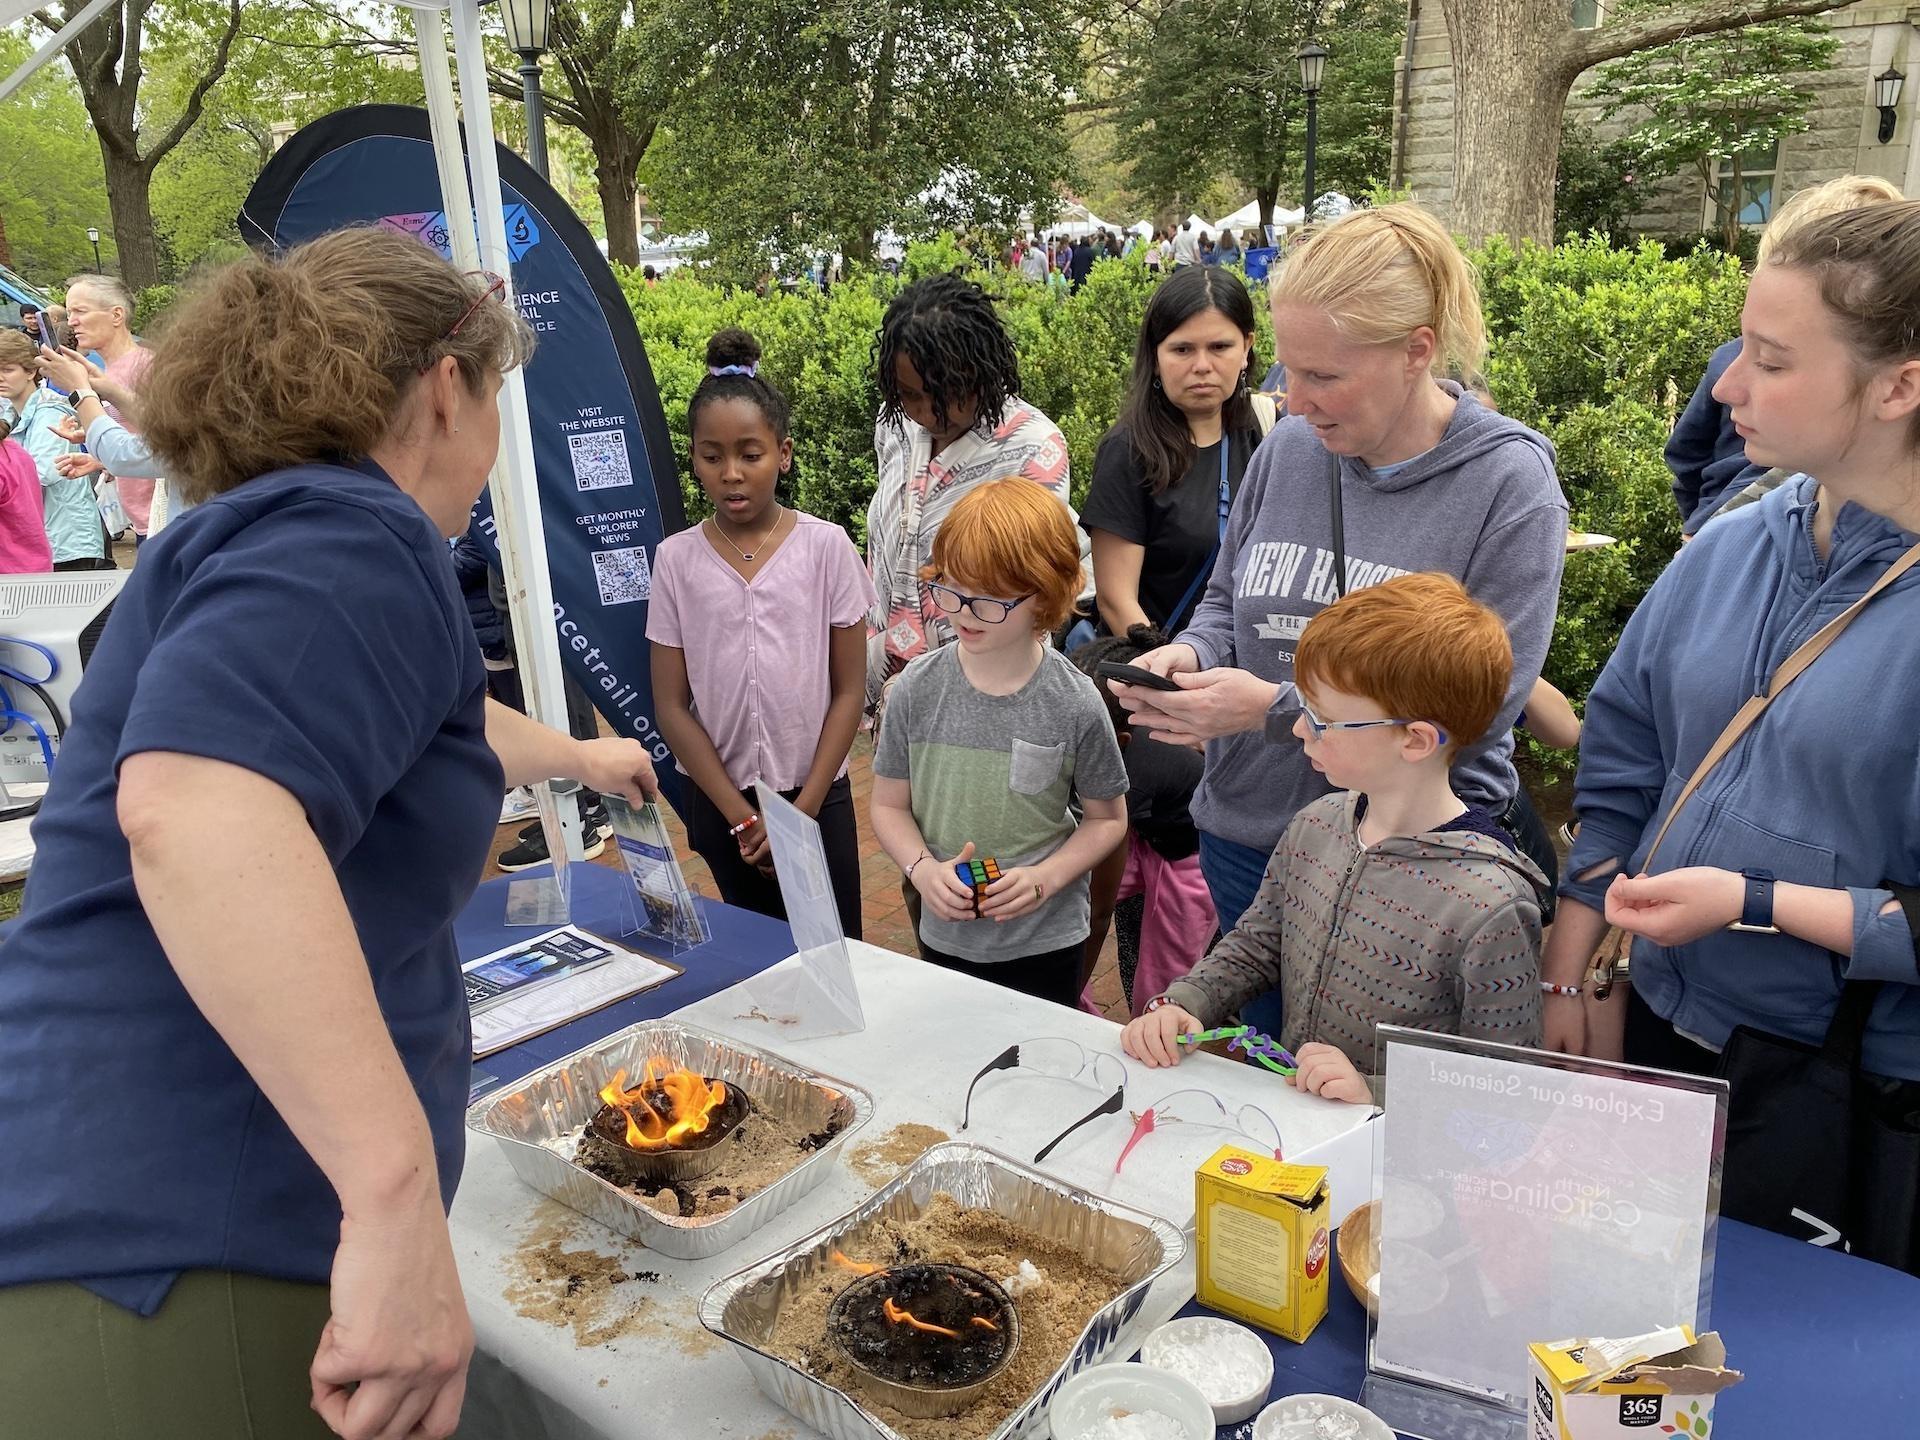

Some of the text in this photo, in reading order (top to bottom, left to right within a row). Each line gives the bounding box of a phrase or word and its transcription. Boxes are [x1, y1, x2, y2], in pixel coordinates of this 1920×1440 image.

[517, 291, 559, 306] IENCE
[520, 307, 542, 319] AIL
[578, 407, 603, 417] VISIT
[559, 416, 626, 431] THE WEBSITE
[576, 508, 646, 525] GET MONTHLY
[588, 521, 639, 535] EXPLORER
[601, 533, 630, 544] NEWS
[1238, 541, 1308, 599] NEW
[1278, 617, 1300, 629] THE
[1623, 1398, 1657, 1416] 365
